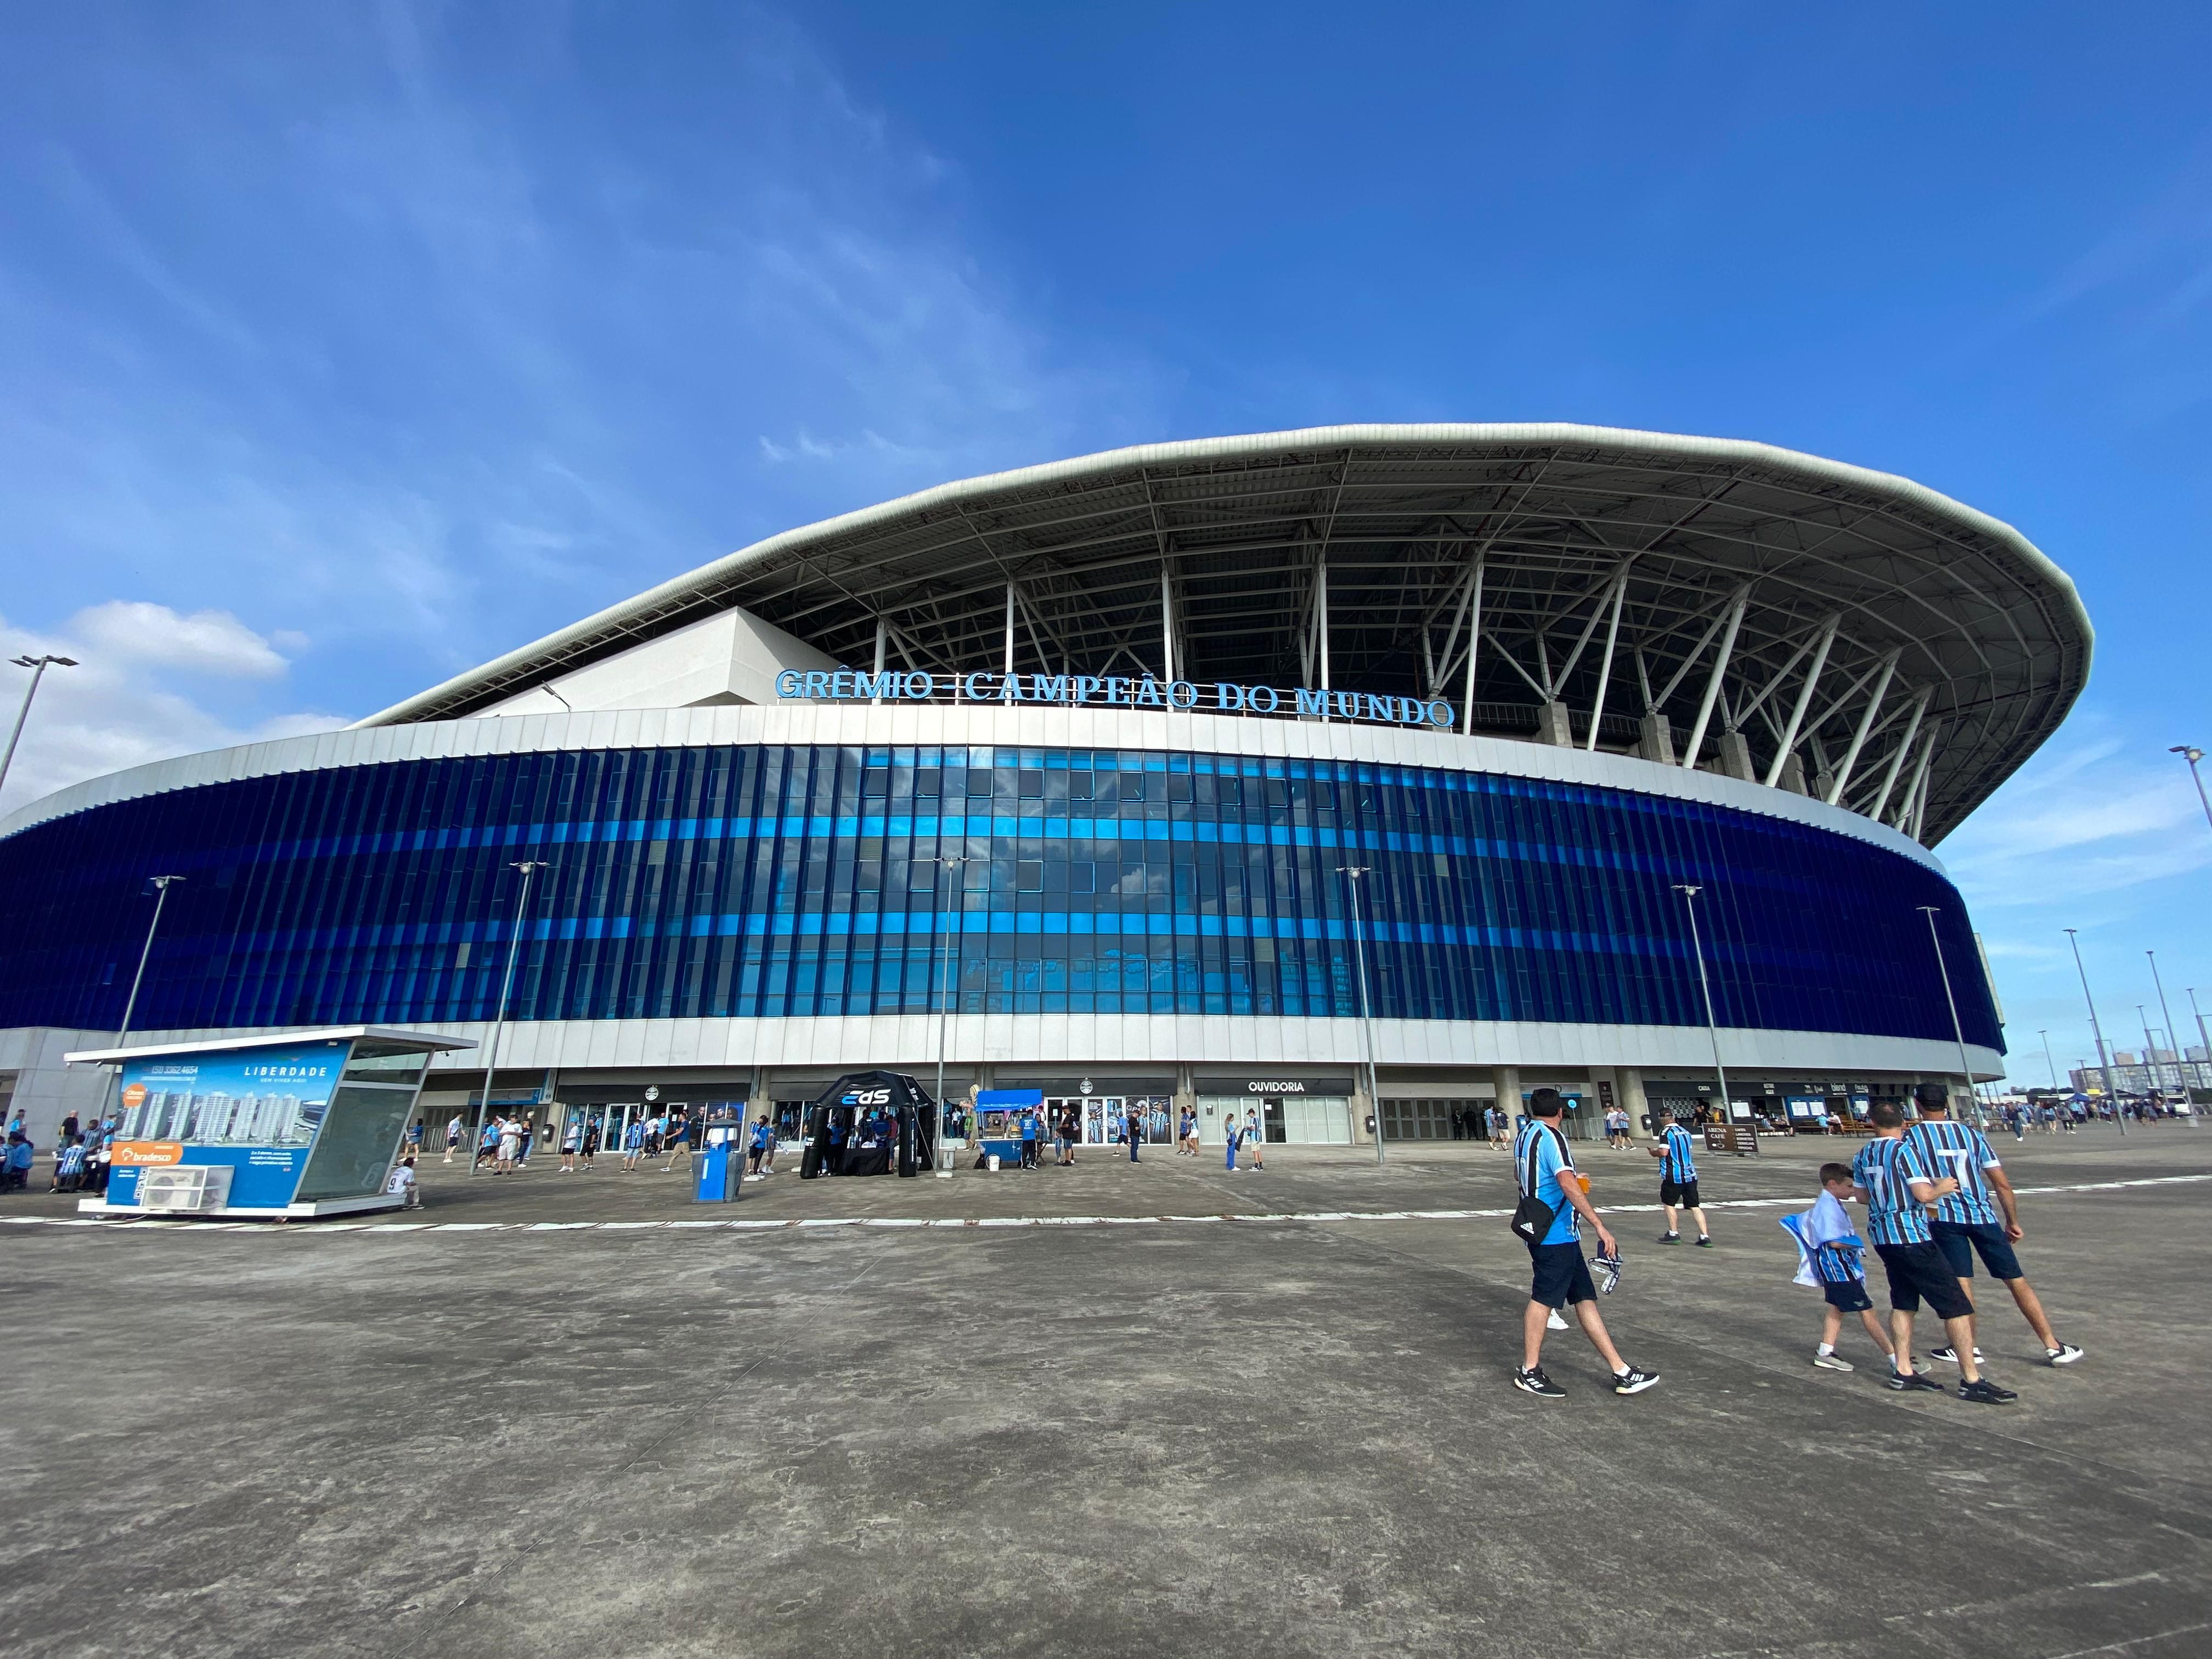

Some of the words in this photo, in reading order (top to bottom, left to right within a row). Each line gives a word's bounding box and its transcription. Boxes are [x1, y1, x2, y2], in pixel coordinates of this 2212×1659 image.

[776, 664, 933, 699] GRÊMIO
[965, 672, 1198, 709] CAMPEÃO
[1214, 681, 1279, 713] DO
[1293, 687, 1456, 728] MUNDO
[244, 1066, 327, 1076] LIBERDADE
[1248, 1081, 1305, 1092] OUVIDORIA
[1554, 1084, 1562, 1093] D
[1830, 1083, 1847, 1092] blend
[635, 1130, 639, 1138] 7
[133, 1152, 172, 1162] bradesco
[1937, 1149, 1970, 1187] 7
[389, 1177, 396, 1190] 9
[1865, 1165, 1886, 1210] 7
